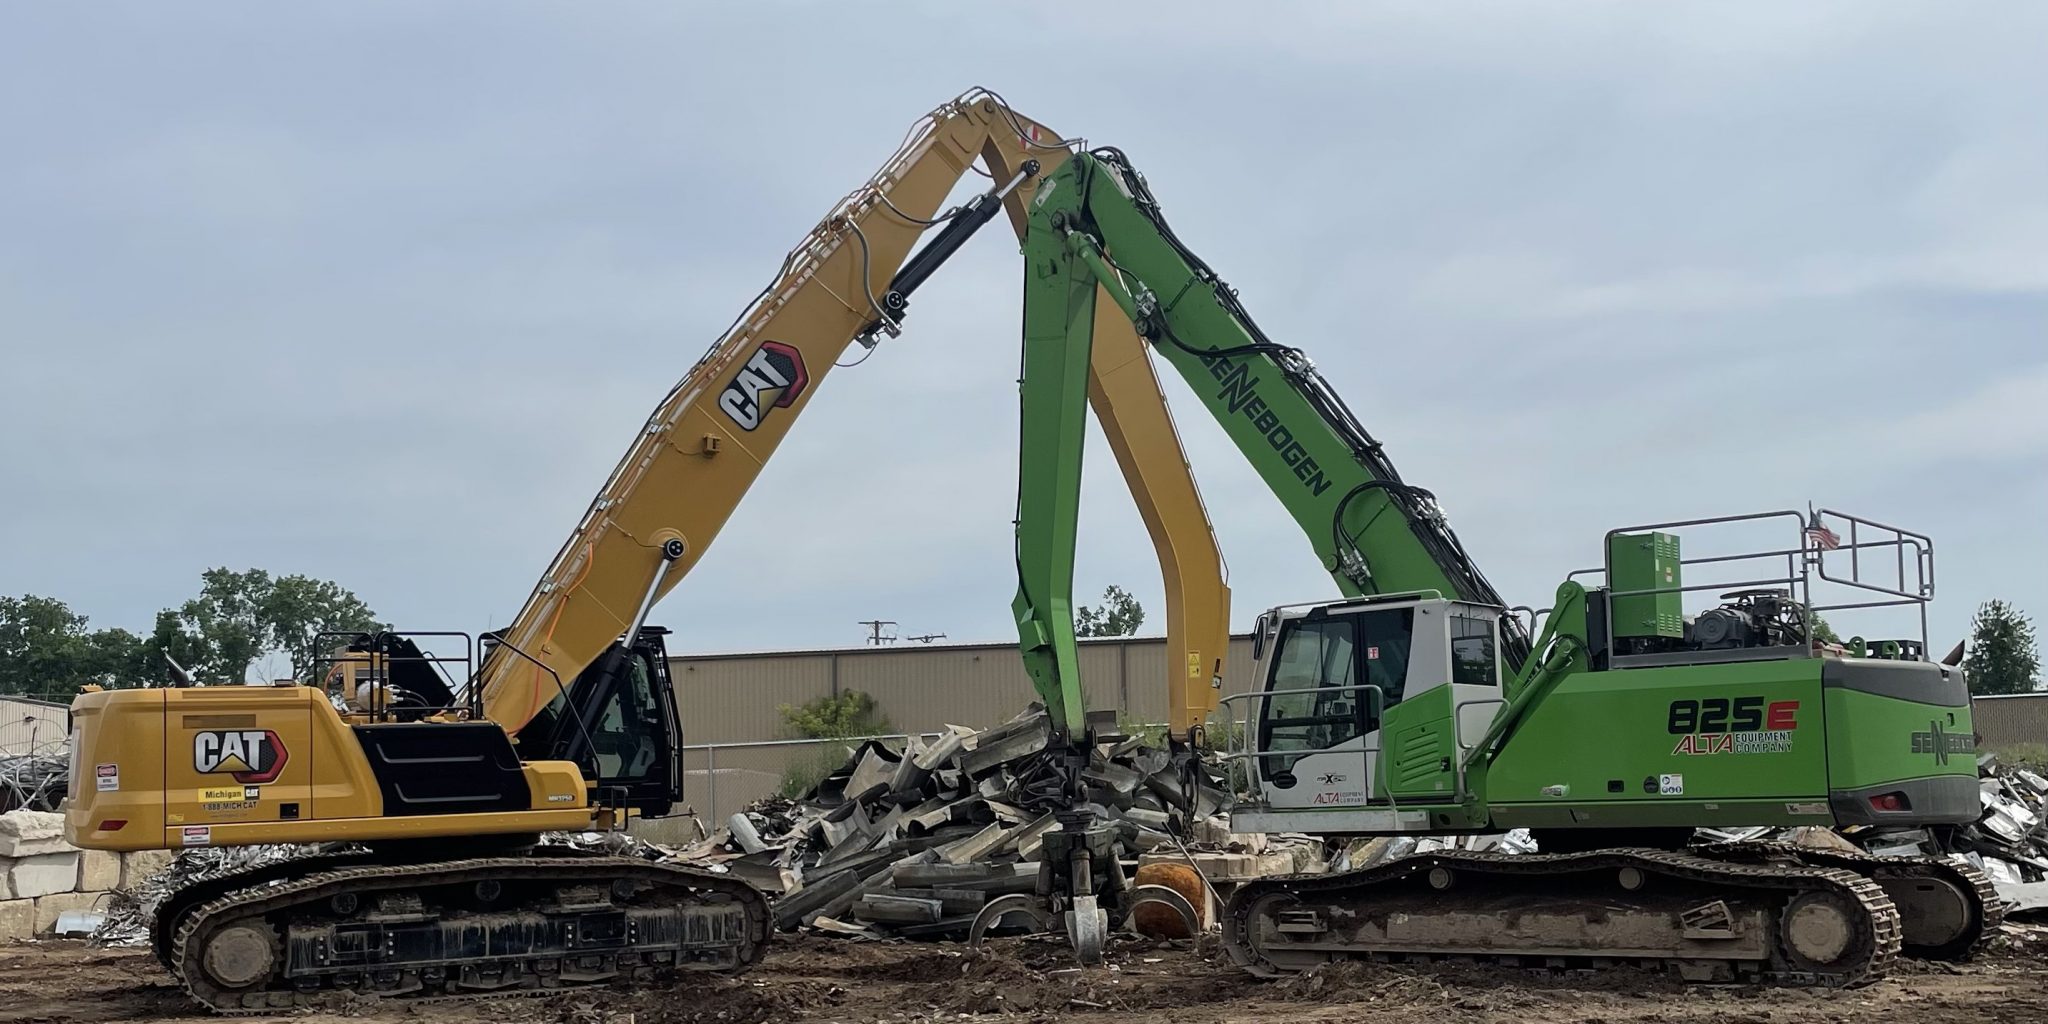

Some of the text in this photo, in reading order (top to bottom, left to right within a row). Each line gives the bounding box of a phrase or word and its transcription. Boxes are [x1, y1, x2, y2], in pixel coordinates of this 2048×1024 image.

[719, 348, 790, 430] CAT
[1200, 344, 1332, 497] SENNEBOGEN
[1667, 696, 1800, 734] 825E
[195, 730, 266, 773] CAT
[1671, 731, 1793, 755] ALTA EQUIPMENT
[1735, 742, 1793, 754] COMPANY
[205, 790, 242, 799] Michigan
[243, 801, 257, 809] CAT
[1313, 792, 1340, 805] ALTA
